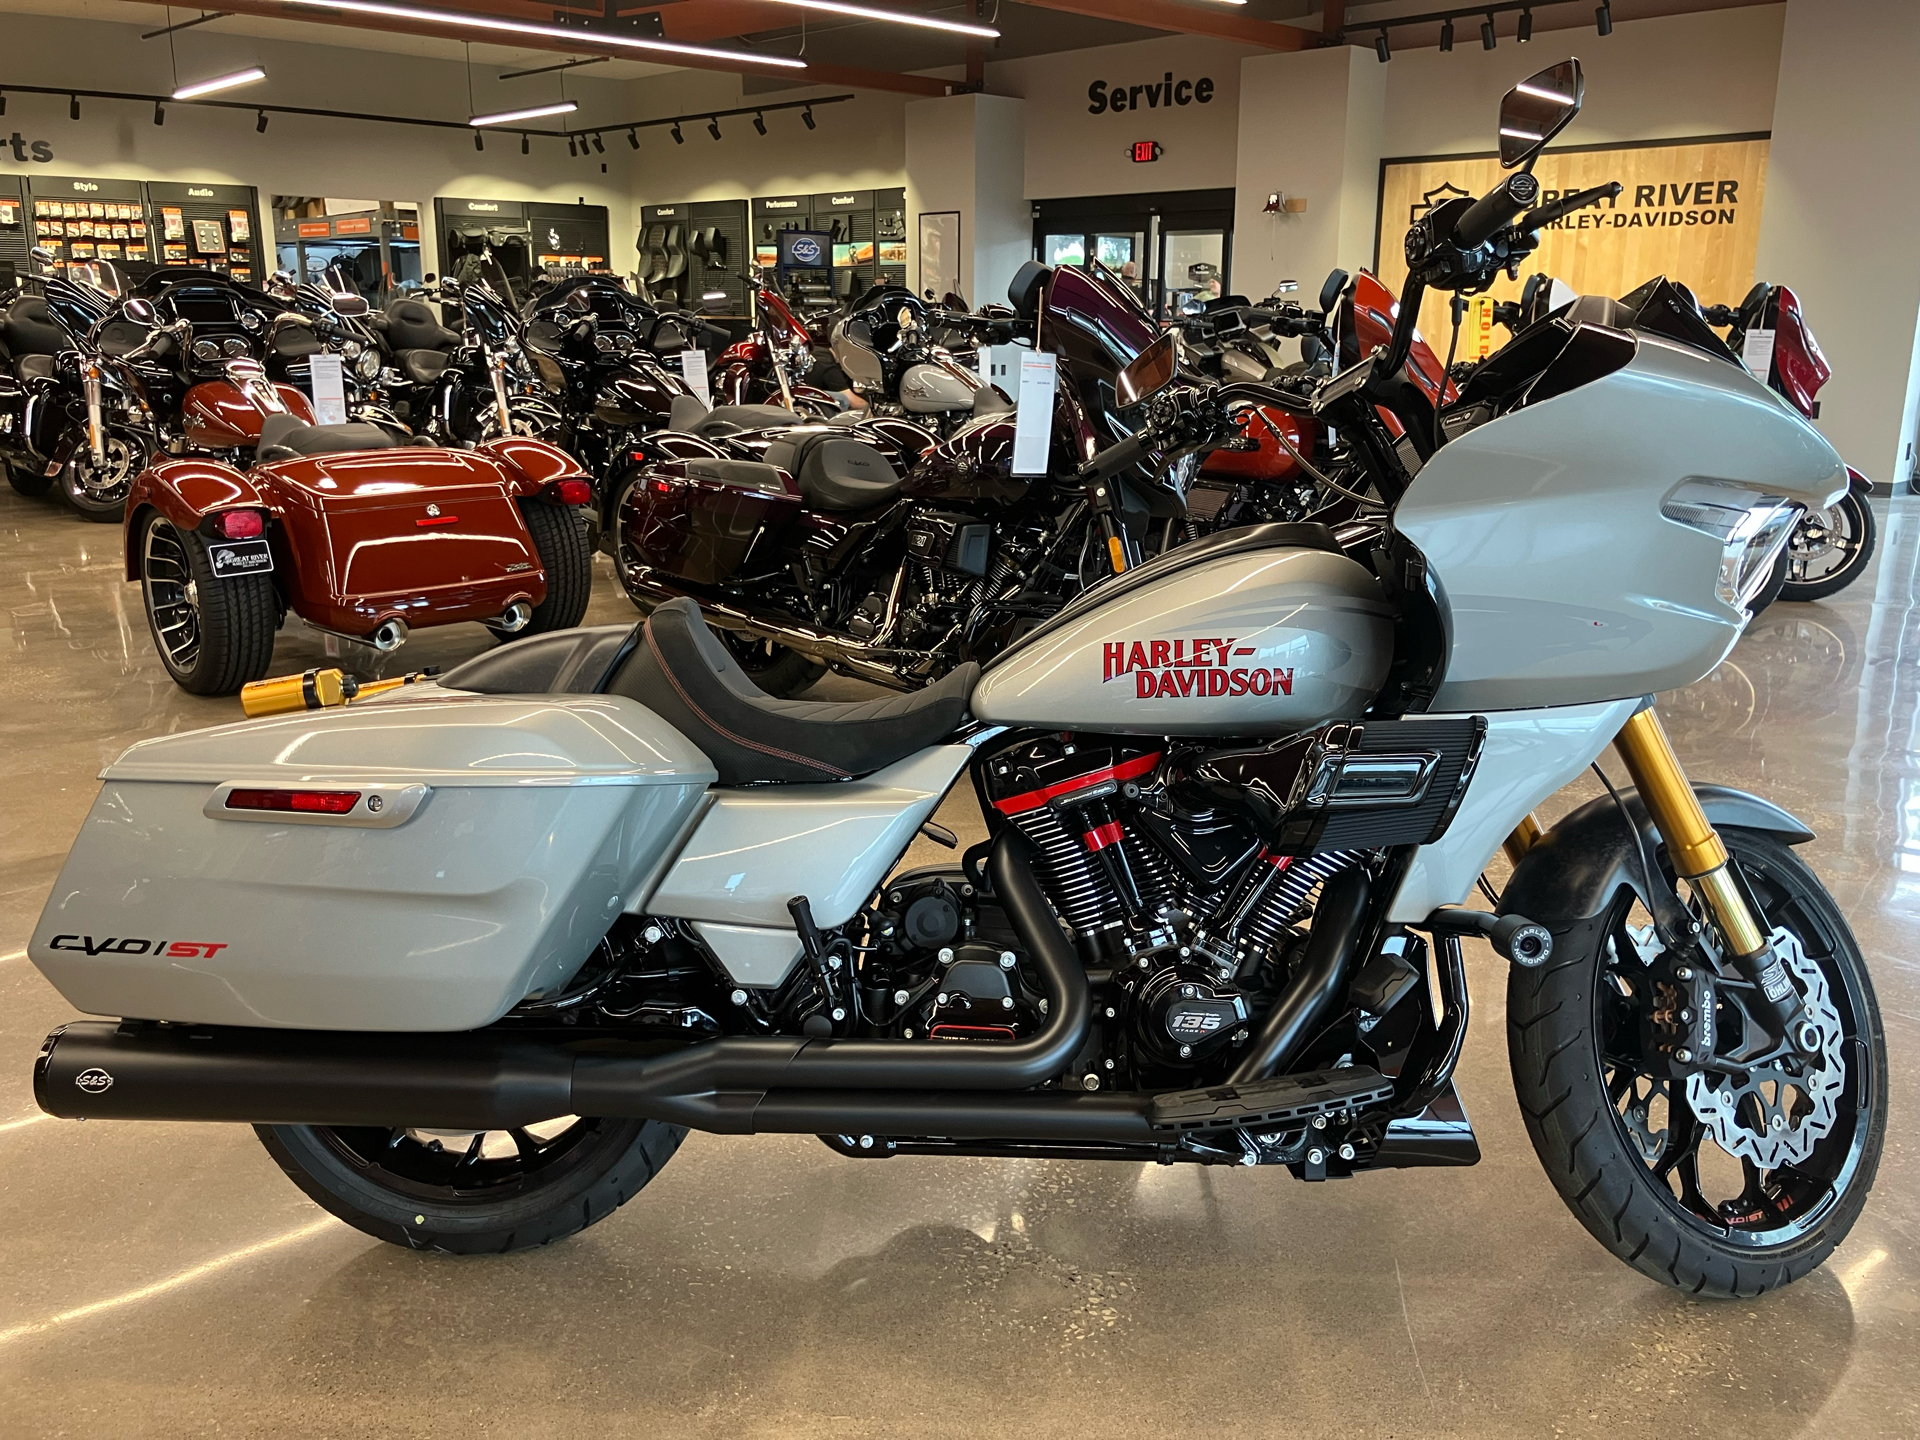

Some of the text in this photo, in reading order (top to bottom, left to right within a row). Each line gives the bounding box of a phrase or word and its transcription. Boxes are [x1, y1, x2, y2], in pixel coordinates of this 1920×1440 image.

[1087, 71, 1214, 115] Service
[1135, 142, 1153, 162] EXIT
[73, 181, 99, 192] Style
[188, 187, 214, 197] Audio
[832, 196, 854, 206] Comfort
[1634, 180, 1739, 208] RIVER
[468, 202, 499, 212] Comfort
[766, 200, 797, 209] Performance
[657, 208, 675, 216] Comfort
[1541, 208, 1736, 231] RLEY-DAVIDSON
[796, 243, 816, 255] S&S
[1102, 638, 1257, 684] HARLEY-
[1136, 667, 1295, 699] DAVIDSON
[1516, 928, 1549, 941] HARLEY
[1513, 948, 1550, 964] DAVIDSON
[1171, 1015, 1222, 1030] 135
[1701, 990, 1711, 1047] brembo
[81, 1075, 108, 1087] S&S
